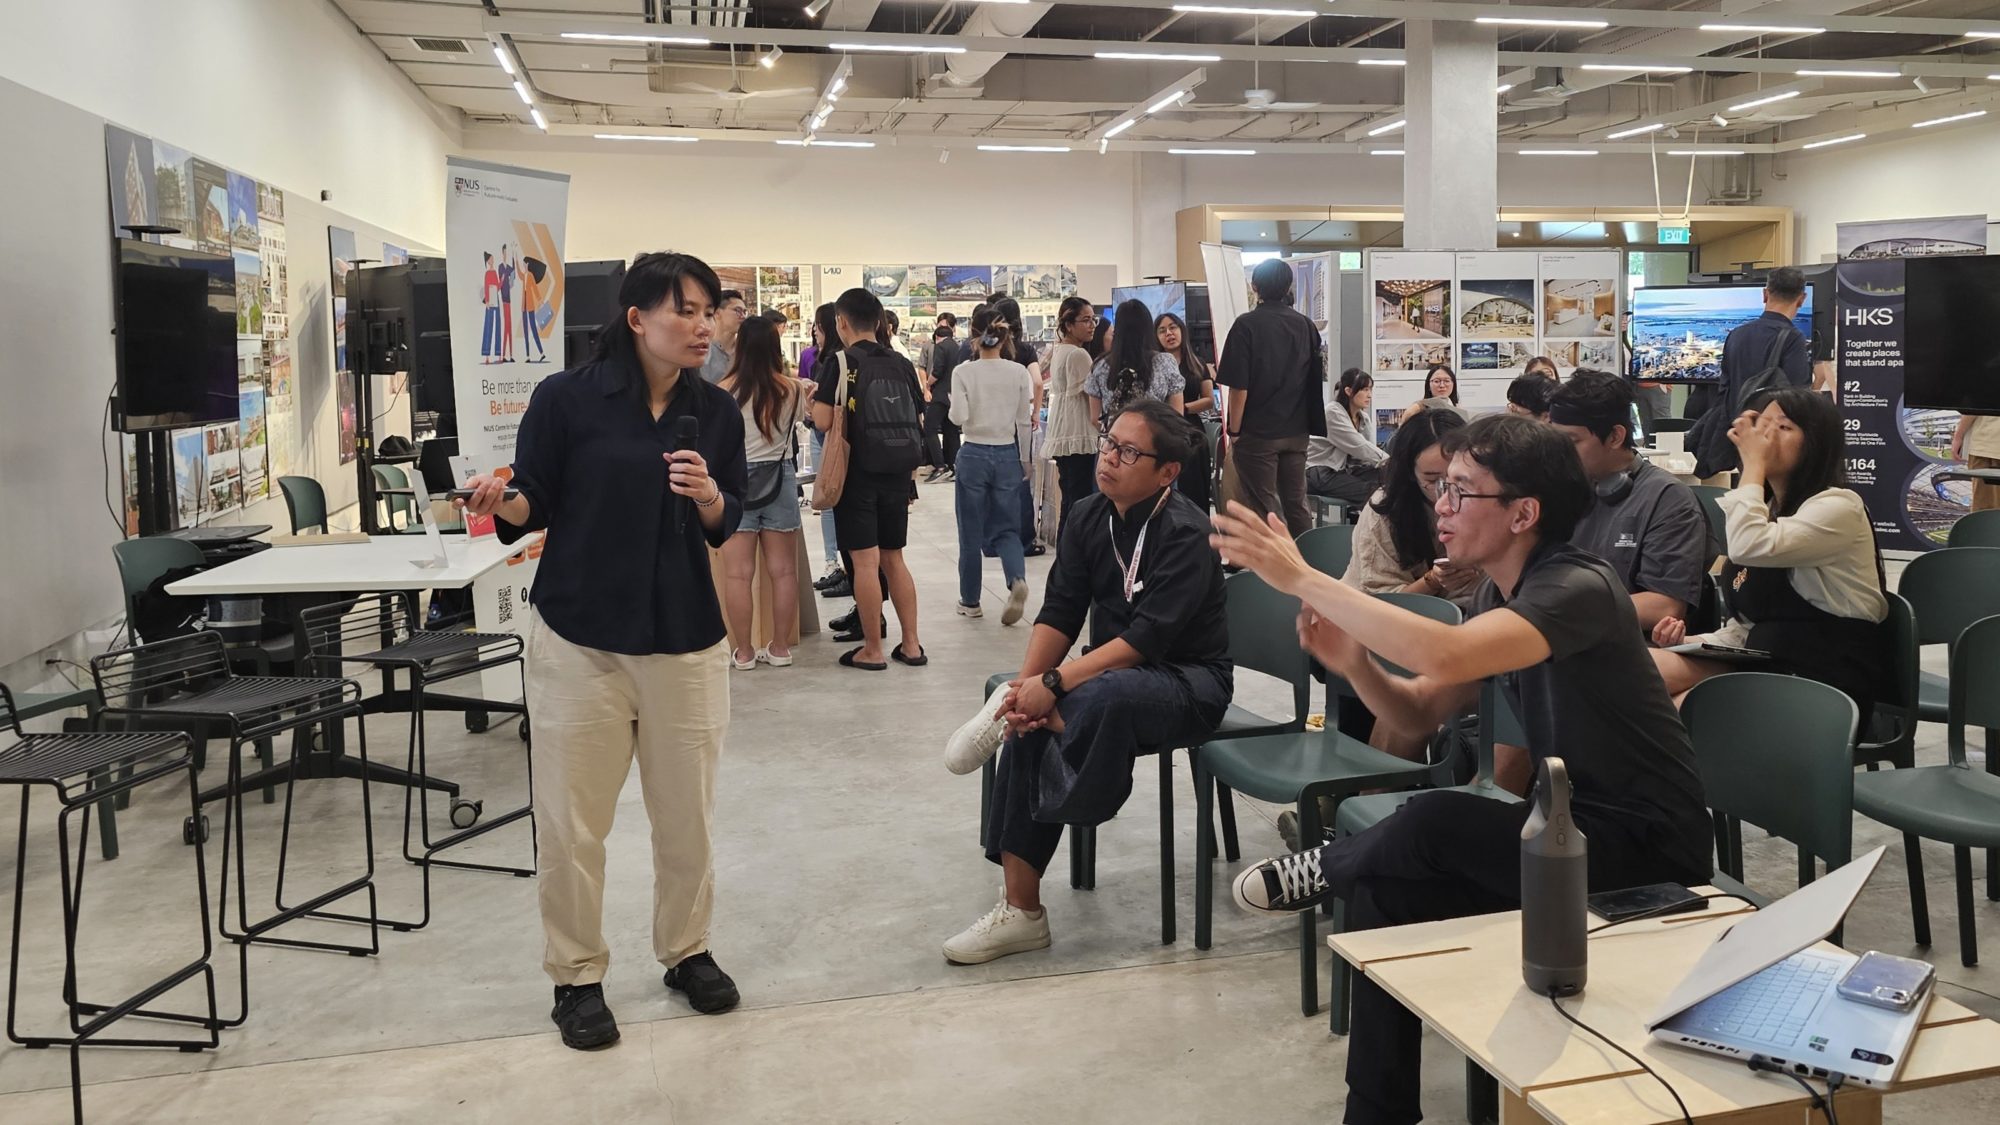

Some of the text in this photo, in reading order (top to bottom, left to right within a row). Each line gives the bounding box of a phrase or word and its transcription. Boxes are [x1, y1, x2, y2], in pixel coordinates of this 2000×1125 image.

[464, 179, 480, 190] NUS
[1666, 231, 1682, 240] EXIT
[1846, 308, 1894, 326] HKS
[1846, 340, 1882, 349] Together
[1873, 349, 1900, 358] places
[482, 380, 496, 395] Be
[497, 382, 514, 394] more
[516, 378, 531, 393] than
[1844, 381, 1860, 392] #2
[490, 398, 528, 415] Be future-
[1844, 419, 1860, 430] 29
[1844, 459, 1876, 471] 1,164
